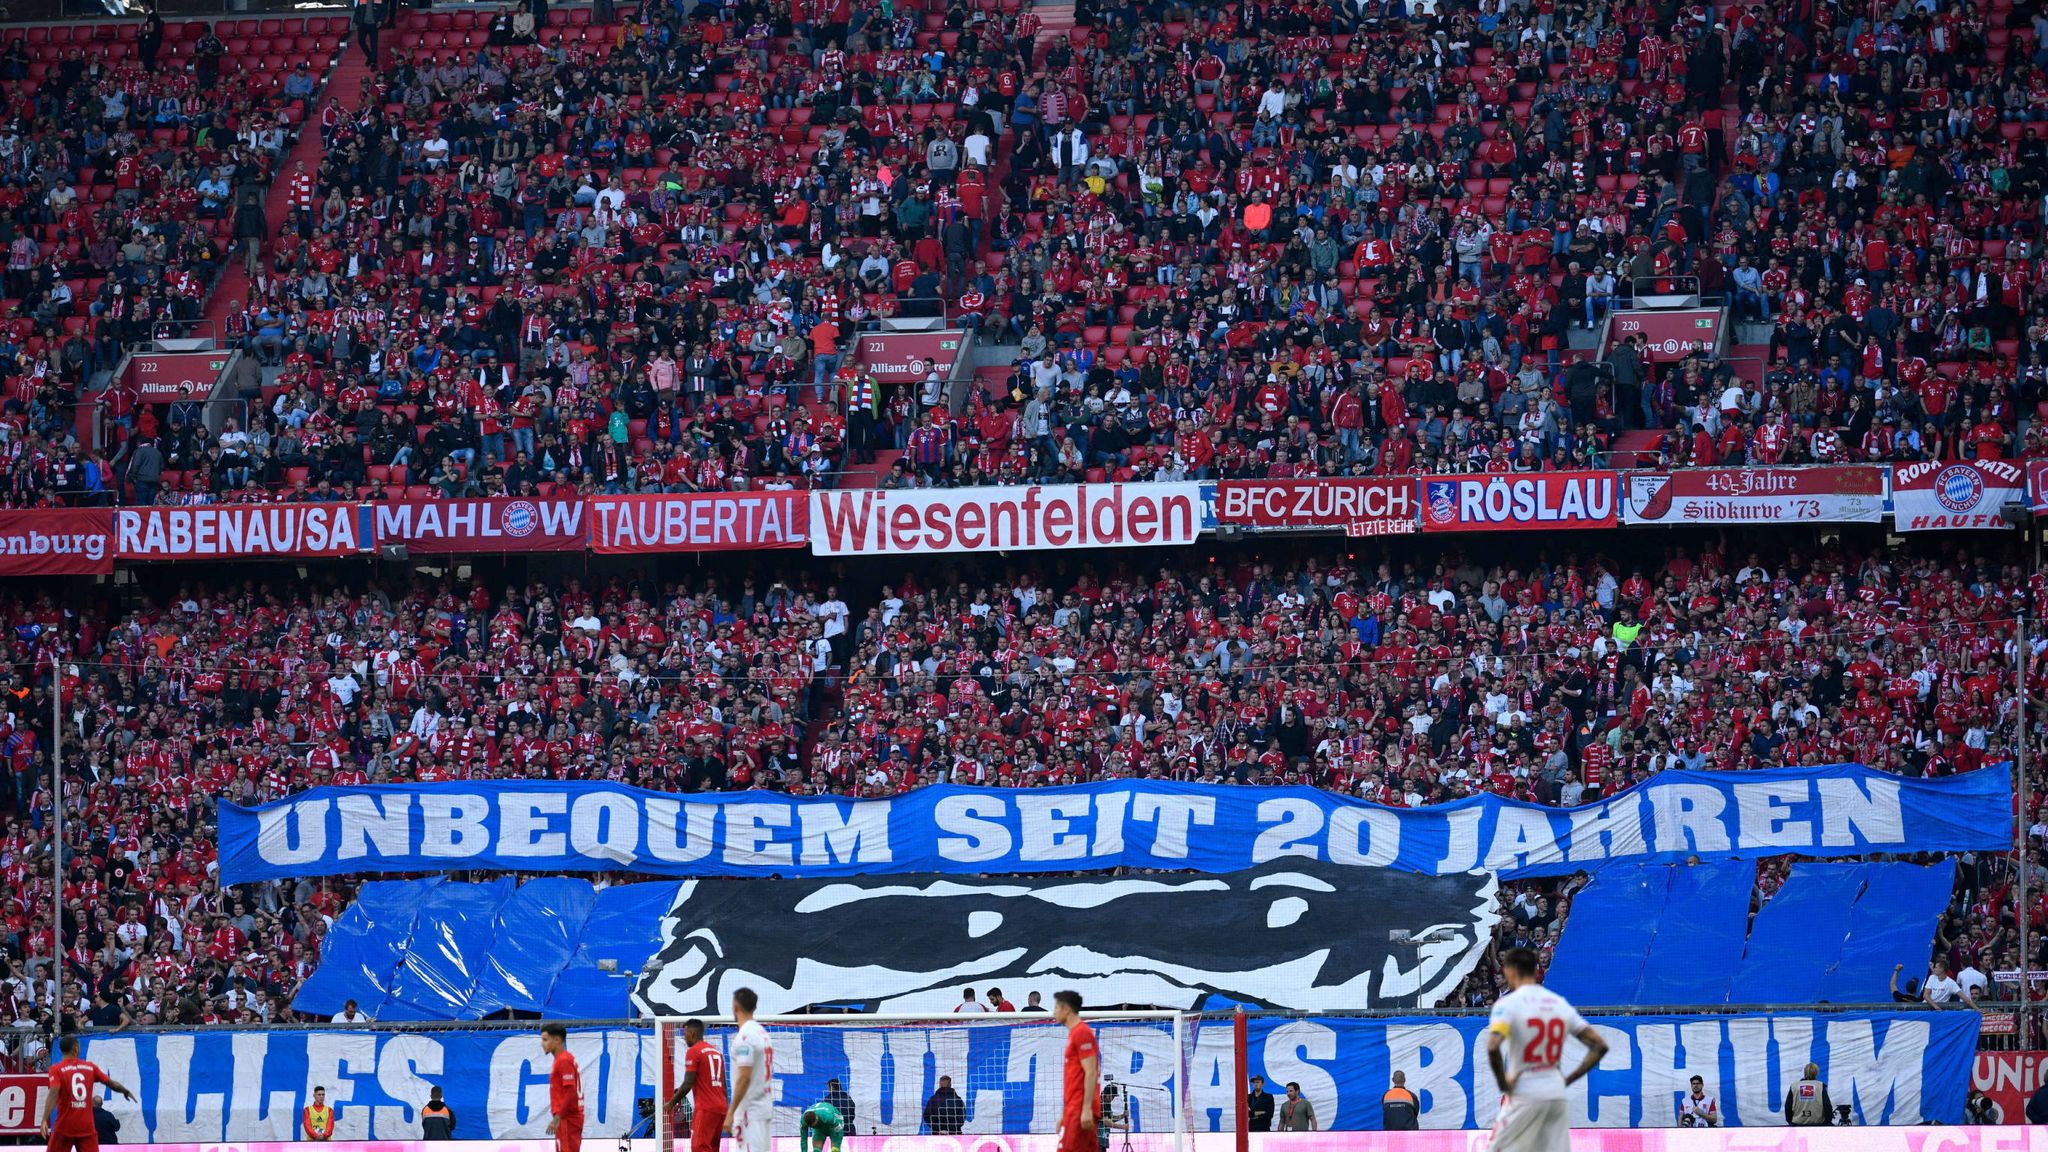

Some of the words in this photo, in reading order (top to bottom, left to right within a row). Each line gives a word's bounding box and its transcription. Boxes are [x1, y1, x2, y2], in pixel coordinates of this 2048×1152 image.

[1004, 75, 1010, 85] 6
[1690, 131, 1697, 144] 7
[119, 160, 129, 171] 25
[938, 192, 949, 203] 25
[1621, 321, 1640, 331] 220
[869, 342, 885, 352] 221
[1681, 340, 1713, 351] Arna
[141, 362, 158, 372] 222
[870, 363, 908, 373] Allianz
[141, 382, 178, 393] Allianz
[1897, 460, 1942, 485] RODA
[1974, 458, 2022, 483] BATZI
[1938, 474, 1948, 486] FC
[1947, 467, 1980, 486] BAYERN
[1739, 469, 1798, 494] Jahre
[1225, 486, 1287, 517] BFC
[1292, 482, 1408, 516] ZÜRICH
[1460, 476, 1612, 523] RÖSLAU
[511, 502, 535, 517] BAYERN
[820, 484, 1192, 552] Wiesenfelden
[1683, 500, 1783, 520] Südkurve
[1789, 500, 1821, 519] '73
[119, 506, 355, 553] RABENAU/SA
[595, 498, 805, 547] TAUBERTAL
[1346, 519, 1386, 537] LETZTE
[1859, 589, 1875, 601] 72
[256, 790, 894, 866] UNBEQUEM
[934, 791, 1216, 862] SEIT
[1251, 797, 1400, 867] 20
[1437, 777, 1905, 874] JAHREN
[1523, 1017, 1565, 1067] 28
[708, 1053, 722, 1081] 17
[71, 1072, 87, 1102] 6
[86, 1031, 444, 1142] ALLES
[843, 1018, 1337, 1137] ULTRAS
[1386, 1017, 1929, 1130] BCHUM
[1802, 1110, 1812, 1118] 13
